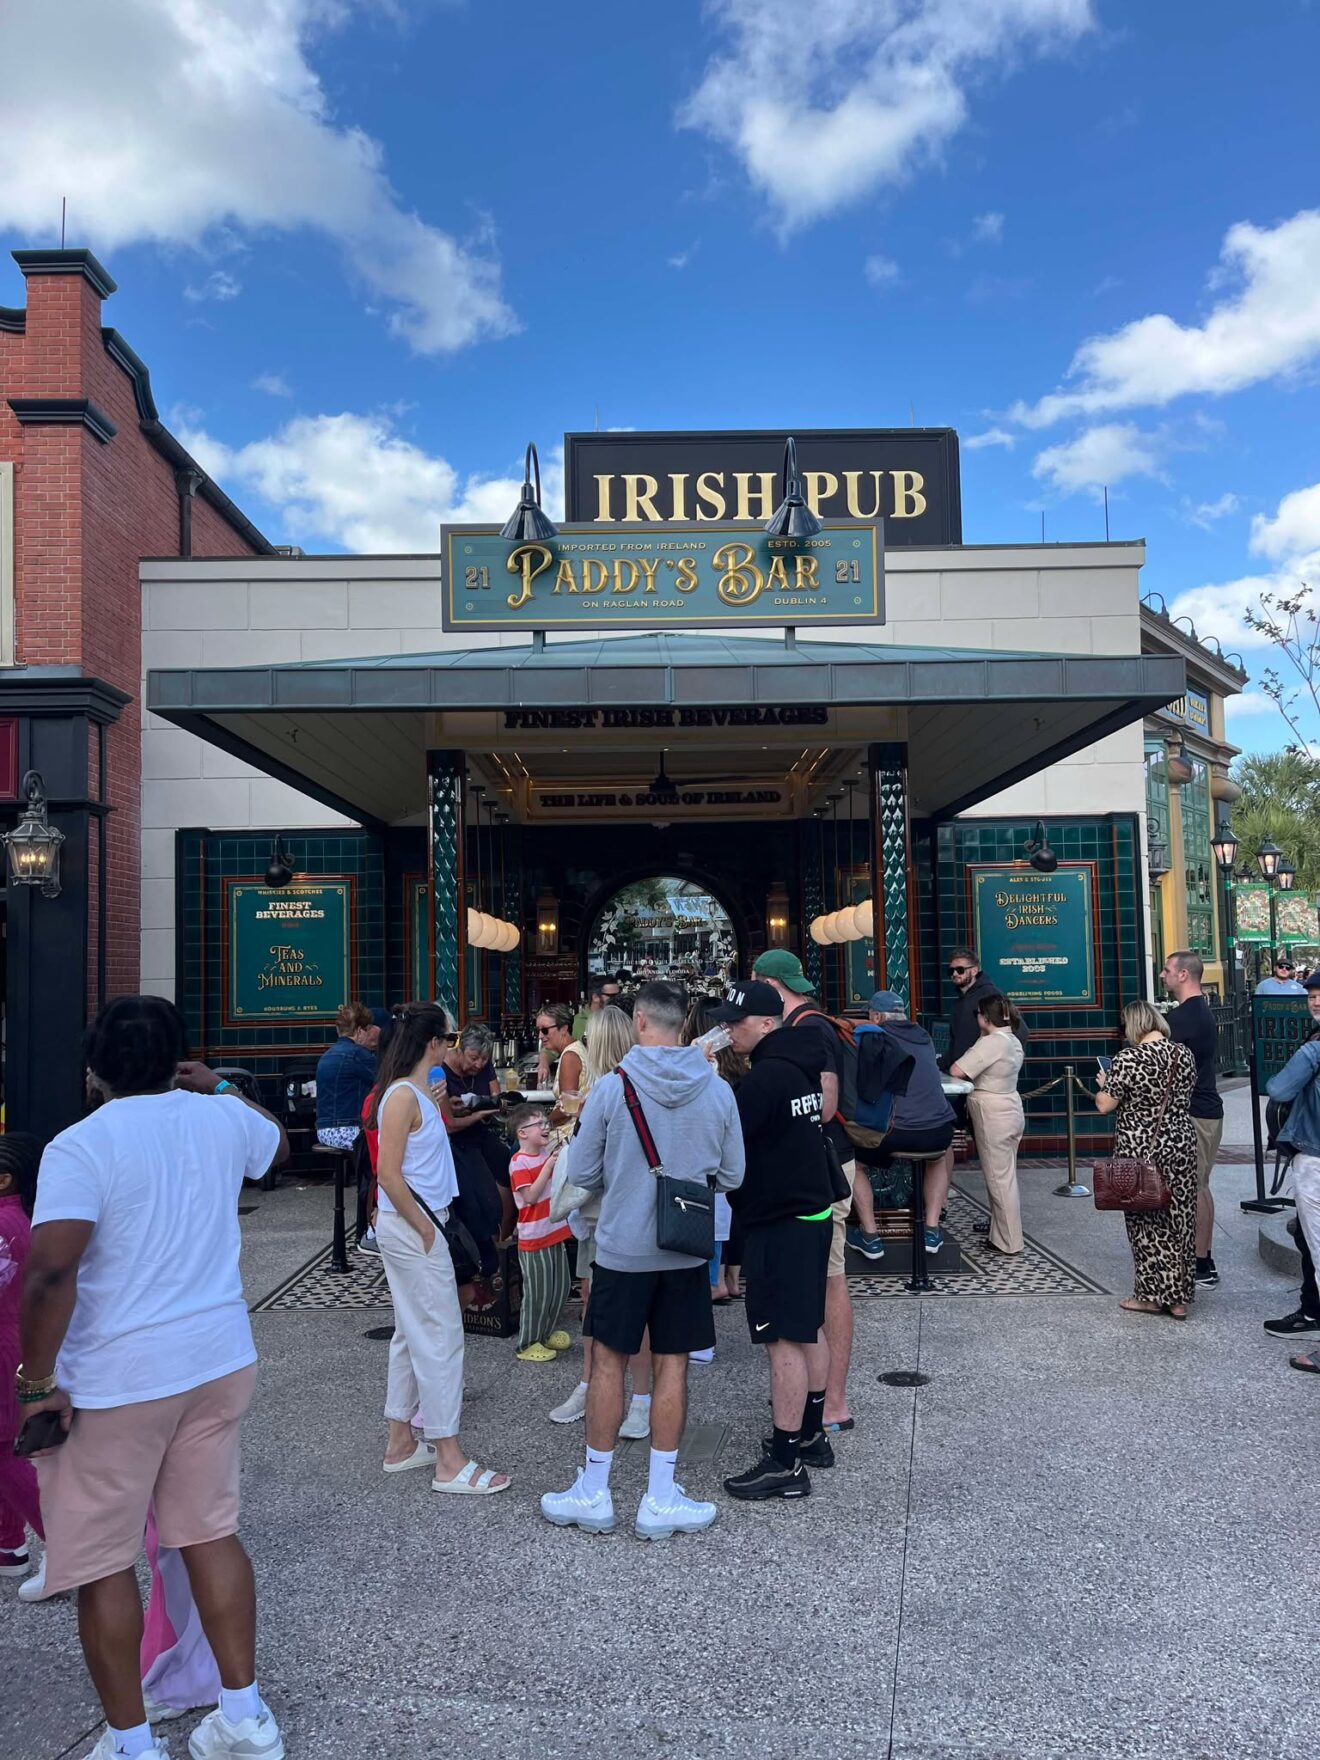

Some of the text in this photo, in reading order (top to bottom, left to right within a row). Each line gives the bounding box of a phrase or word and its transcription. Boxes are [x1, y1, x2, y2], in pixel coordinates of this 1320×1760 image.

[593, 470, 927, 522] IRISH PUB
[557, 542, 706, 552] IMPORTED FROM IRELAND
[767, 540, 832, 548] ESTD. 2005
[465, 566, 491, 589] 21
[506, 542, 820, 609] PADDY'S BAR
[836, 559, 861, 583] 21
[582, 599, 685, 608] ON RAGLAN ROAD
[774, 597, 828, 605] DUBLIN 4
[504, 706, 828, 728] FINEST IRISH BEVERAGES
[268, 901, 312, 910] FINEST
[995, 891, 1067, 907] DELIGHTFUL
[255, 910, 325, 919] BEVERAGES
[1019, 904, 1045, 914] IRISH
[1005, 913, 1058, 929] DANCERS
[269, 945, 305, 964] TEAS
[279, 962, 303, 973] AND
[257, 973, 323, 990] MINERALS
[1257, 1017, 1314, 1040] IRISH
[1263, 1042, 1298, 1062] BEE
[463, 1313, 502, 1329] IDEON'S
